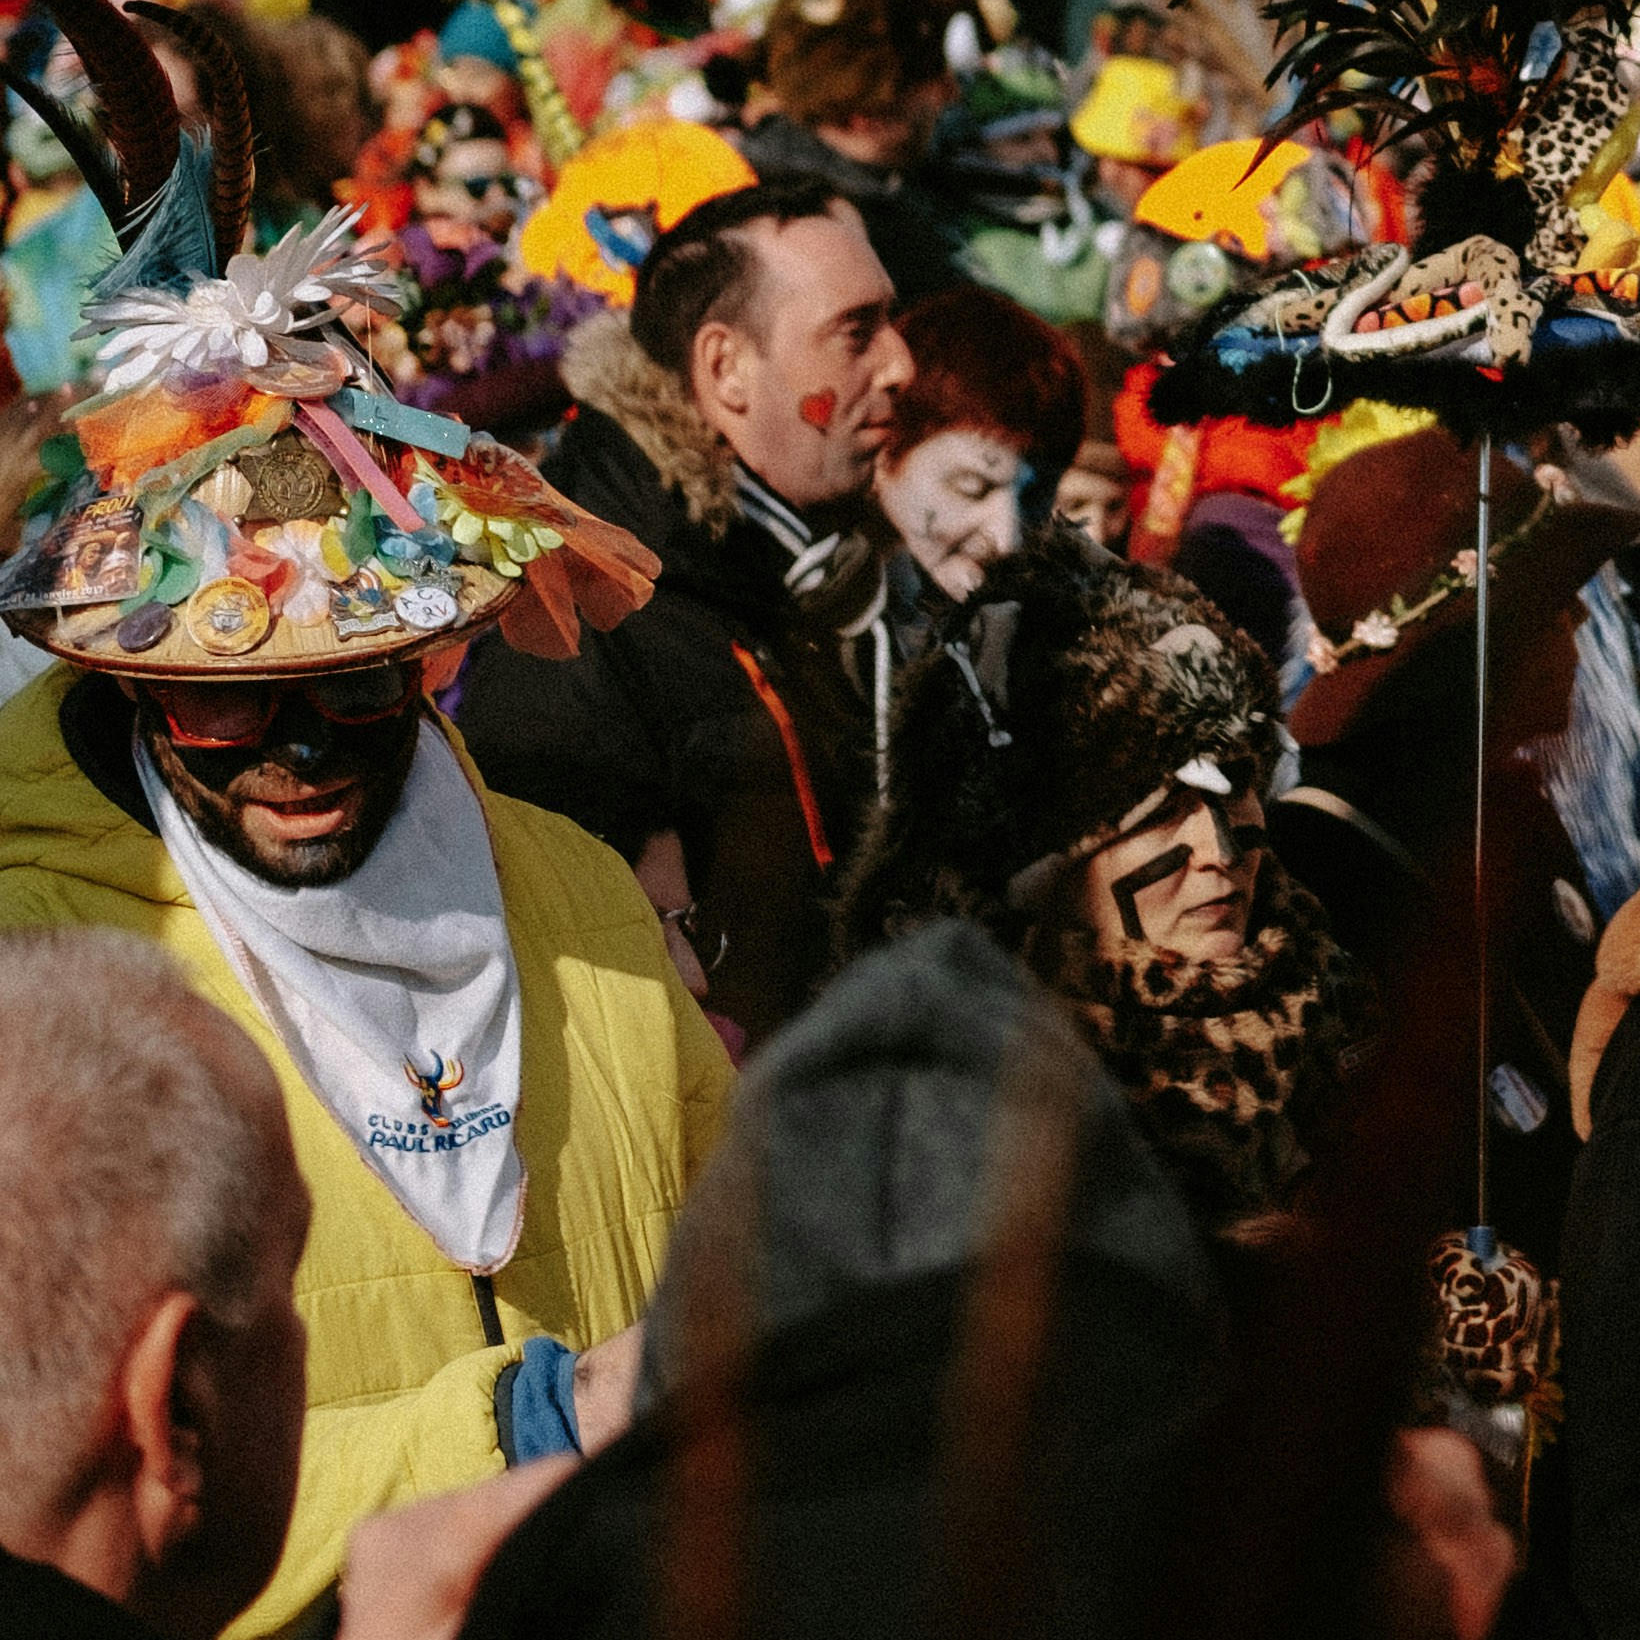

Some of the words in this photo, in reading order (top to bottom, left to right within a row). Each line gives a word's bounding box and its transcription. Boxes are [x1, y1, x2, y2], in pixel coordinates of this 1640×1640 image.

[368, 1113, 430, 1135] CLUBS
[369, 1129, 431, 1153] PAUL
[434, 1110, 511, 1152] RICARD
